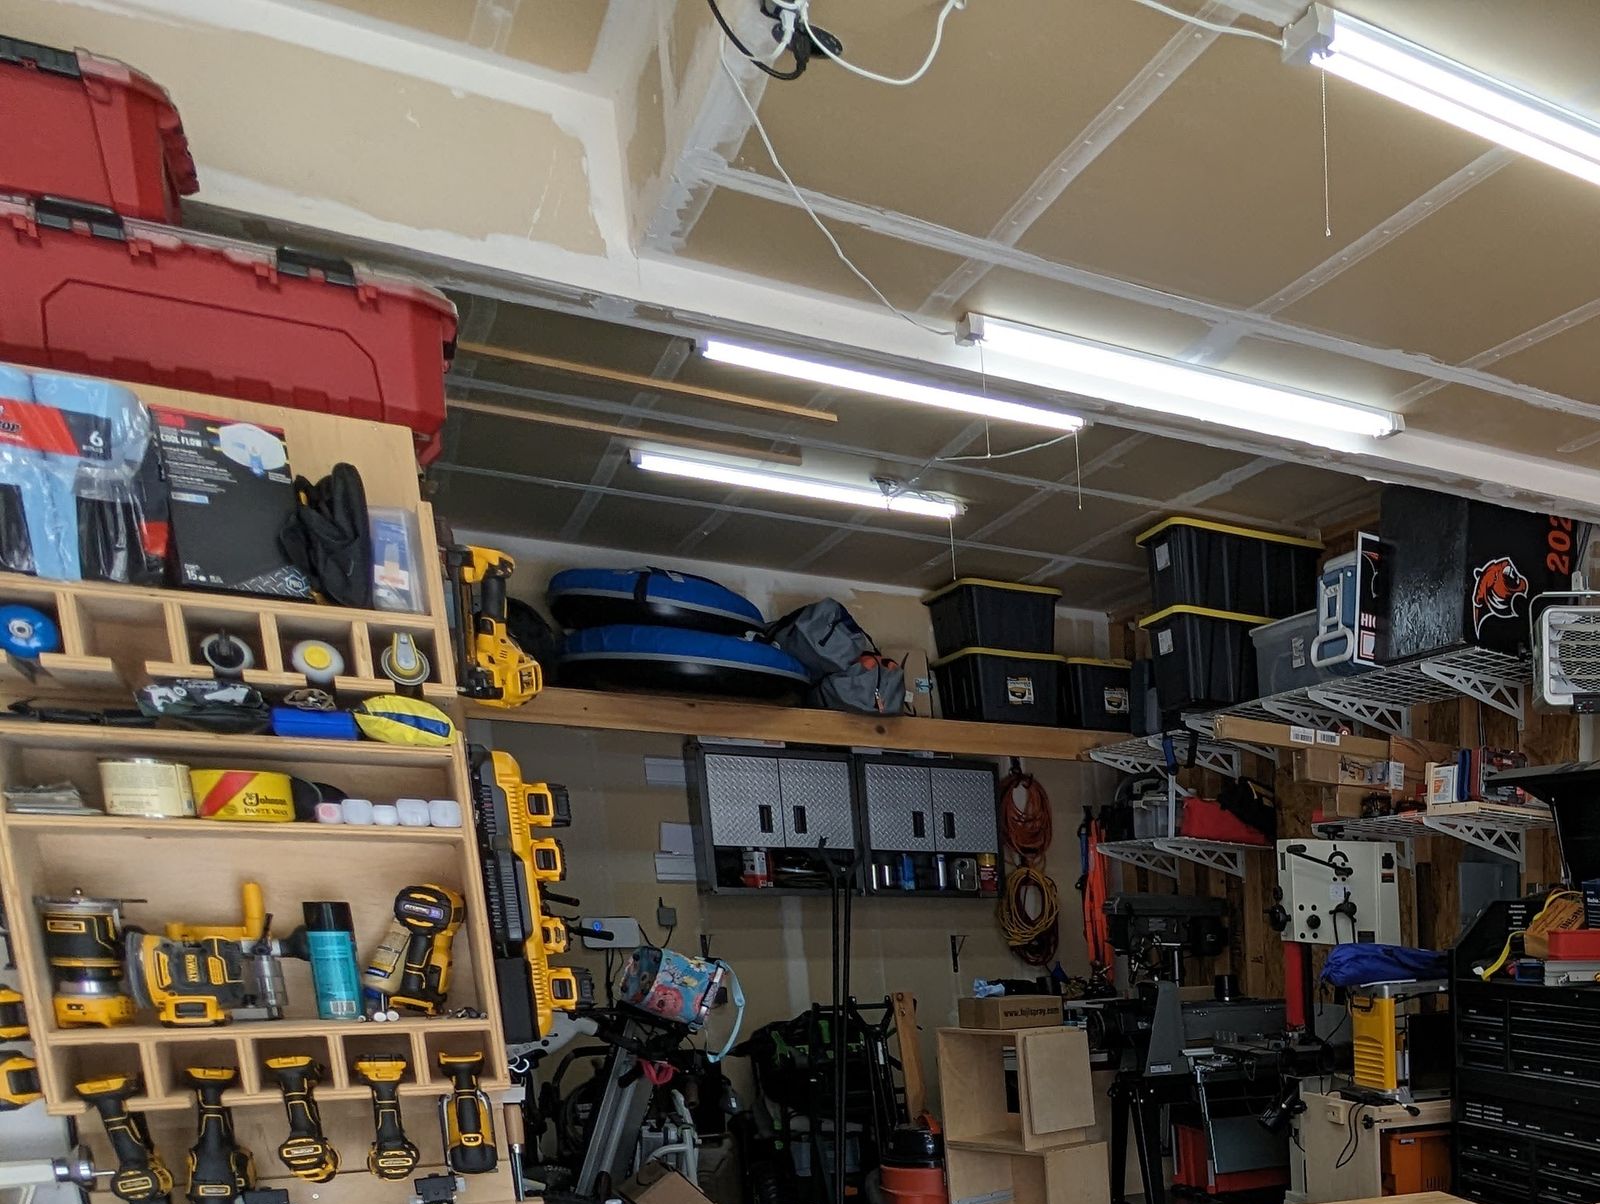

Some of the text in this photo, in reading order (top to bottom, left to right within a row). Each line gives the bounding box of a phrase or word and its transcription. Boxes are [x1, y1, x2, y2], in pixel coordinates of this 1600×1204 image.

[89, 431, 104, 447] 6
[244, 807, 271, 816] PASTE
[185, 954, 200, 984] DEWALT
